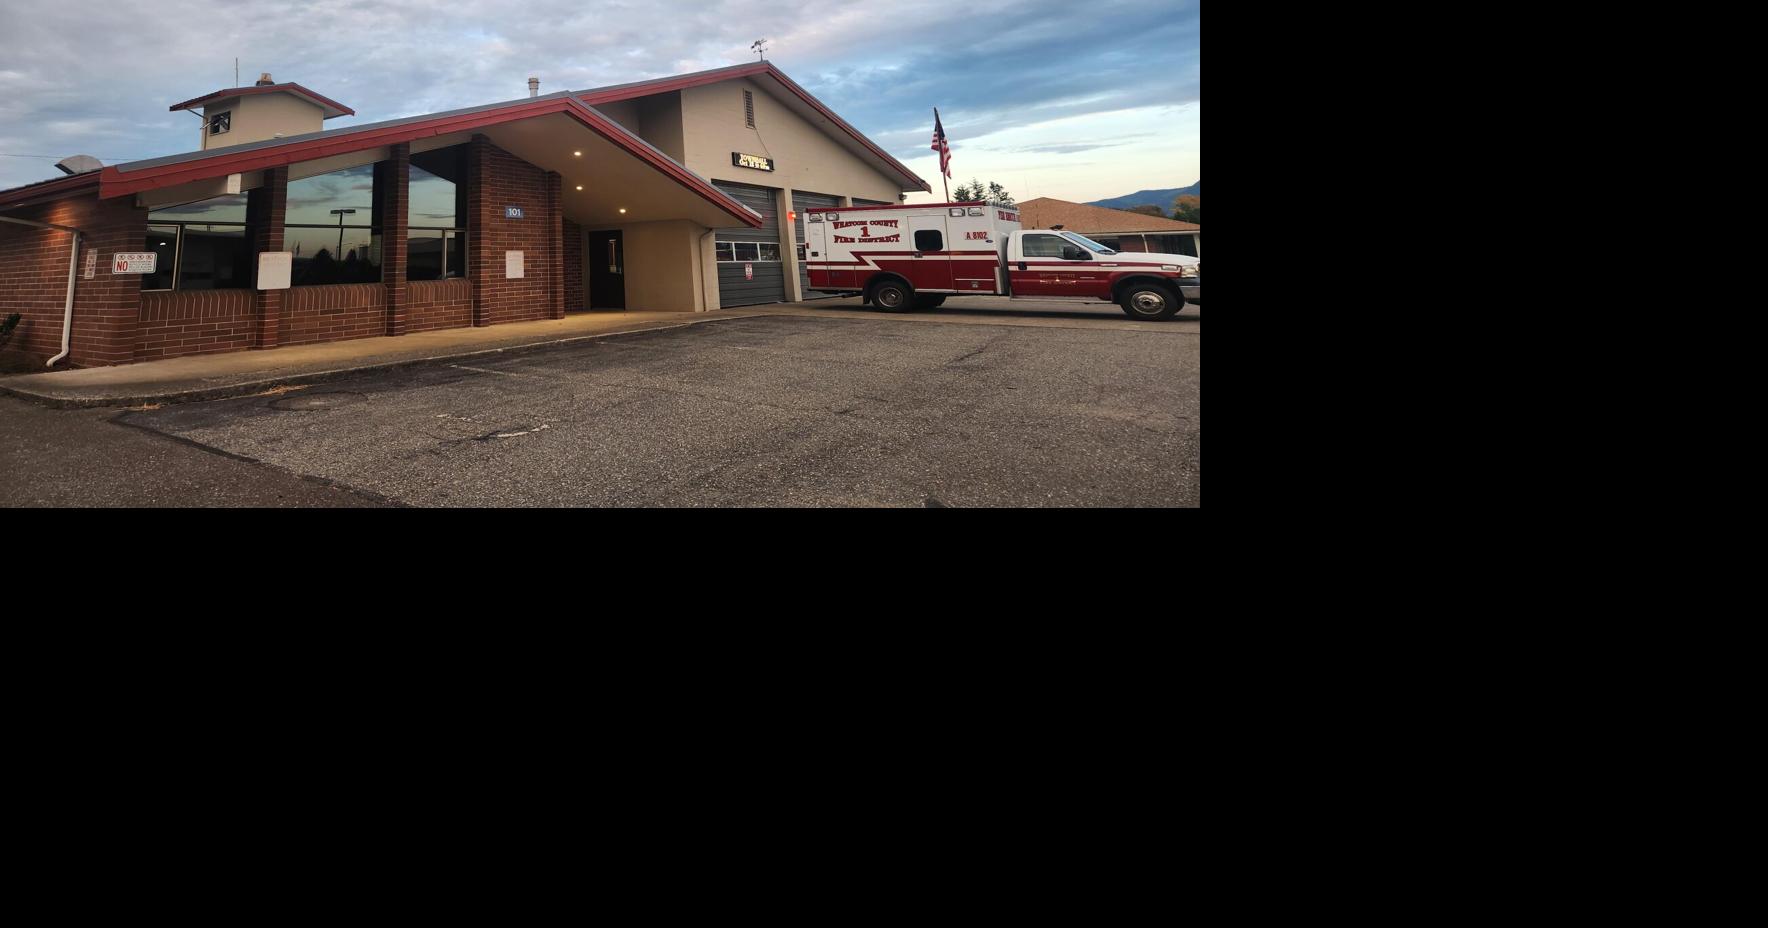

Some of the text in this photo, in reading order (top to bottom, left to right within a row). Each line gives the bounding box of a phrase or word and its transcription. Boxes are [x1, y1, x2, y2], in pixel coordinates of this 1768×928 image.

[508, 208, 521, 216] 101
[832, 219, 898, 230] WHATCOM COUNTY
[860, 226, 870, 237] 1
[972, 231, 988, 240] 8102
[833, 233, 900, 243] FIRE DISTRICT
[116, 260, 128, 271] NO
